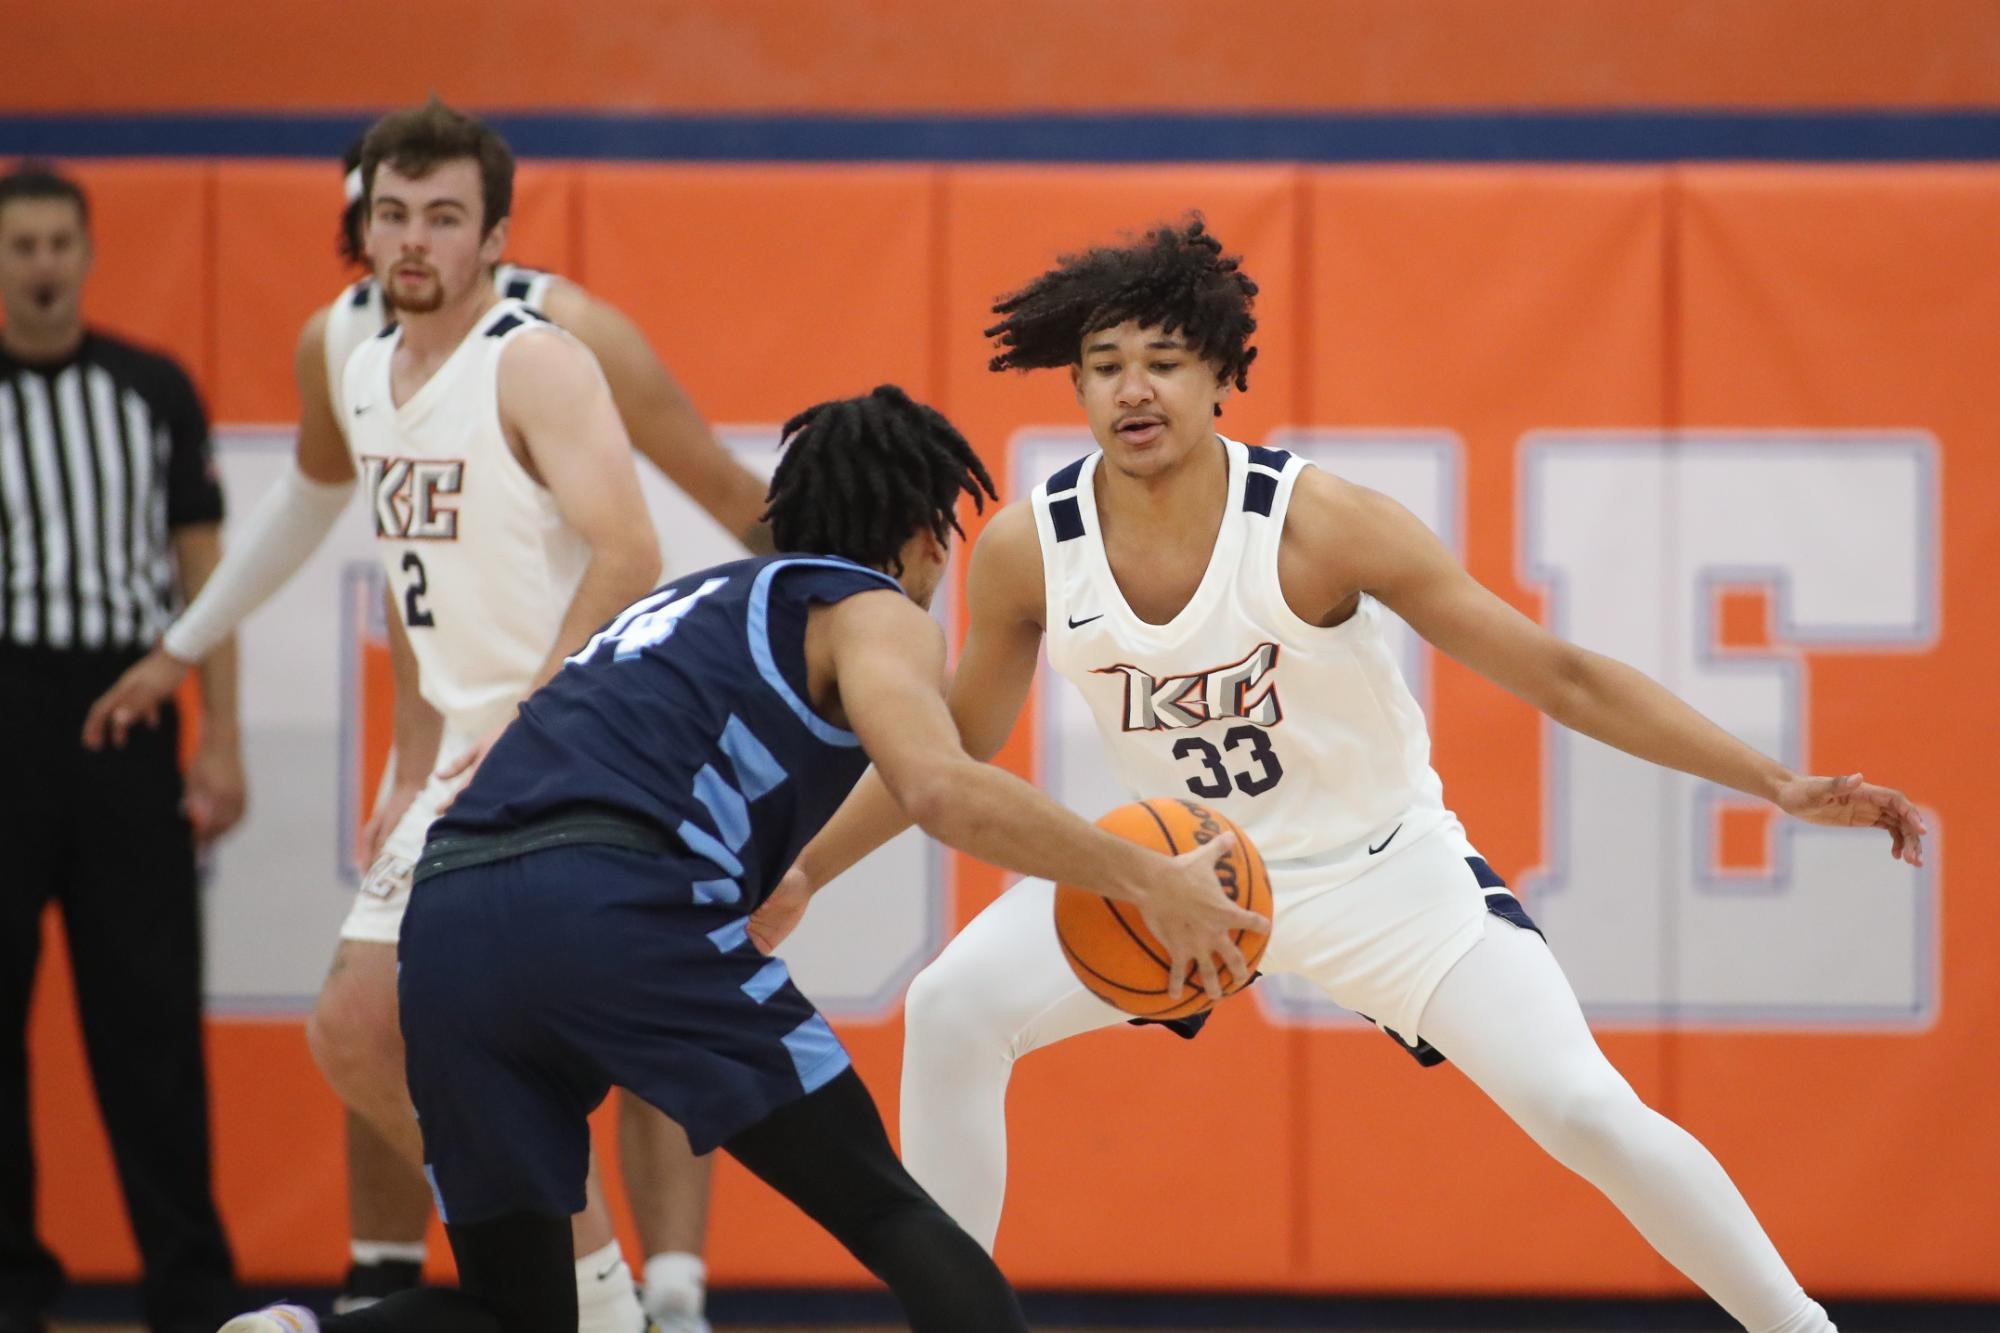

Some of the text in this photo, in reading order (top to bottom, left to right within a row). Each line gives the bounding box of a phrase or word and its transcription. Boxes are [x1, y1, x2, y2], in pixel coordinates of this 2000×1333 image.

[361, 456, 465, 539] KC
[402, 551, 435, 627] 2
[1087, 642, 1284, 732] KC
[1172, 725, 1283, 798] 33
